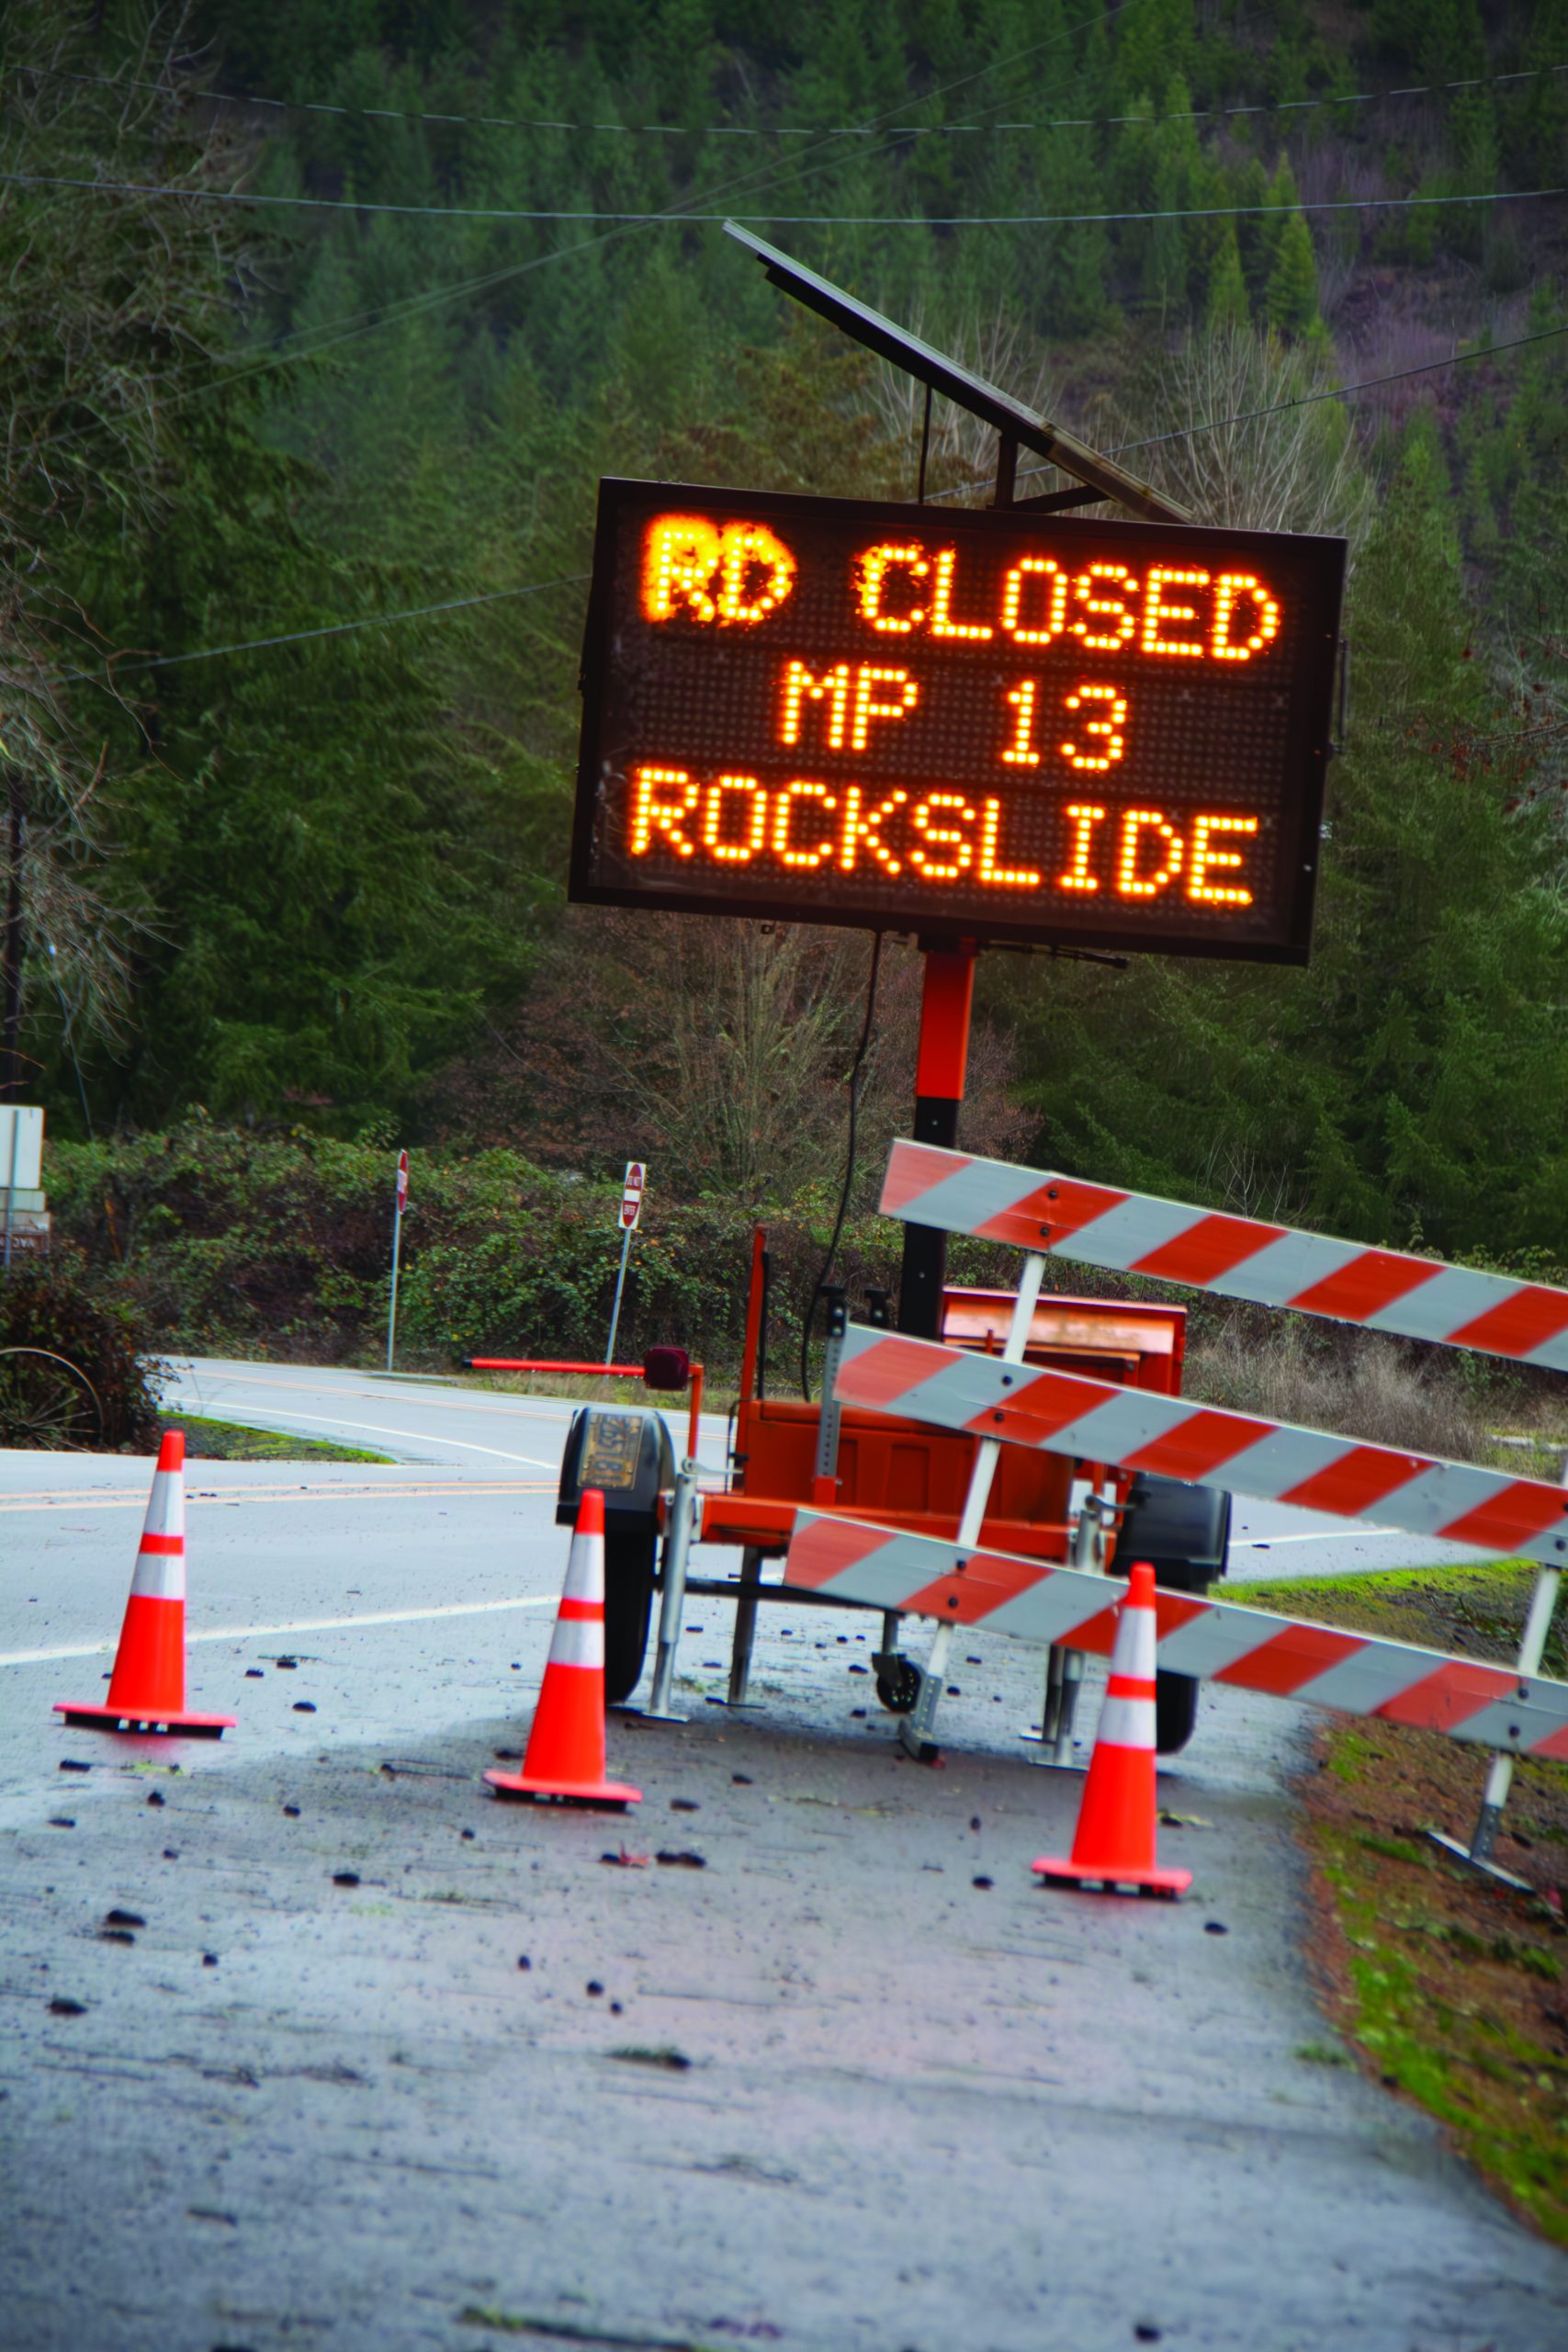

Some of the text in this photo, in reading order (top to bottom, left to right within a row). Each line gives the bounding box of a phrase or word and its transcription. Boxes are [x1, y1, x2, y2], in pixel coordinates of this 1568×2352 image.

[645, 514, 1281, 660] RD CLOSED
[781, 661, 1128, 770] MP 13
[628, 766, 1258, 905] ROCKSLIDE
